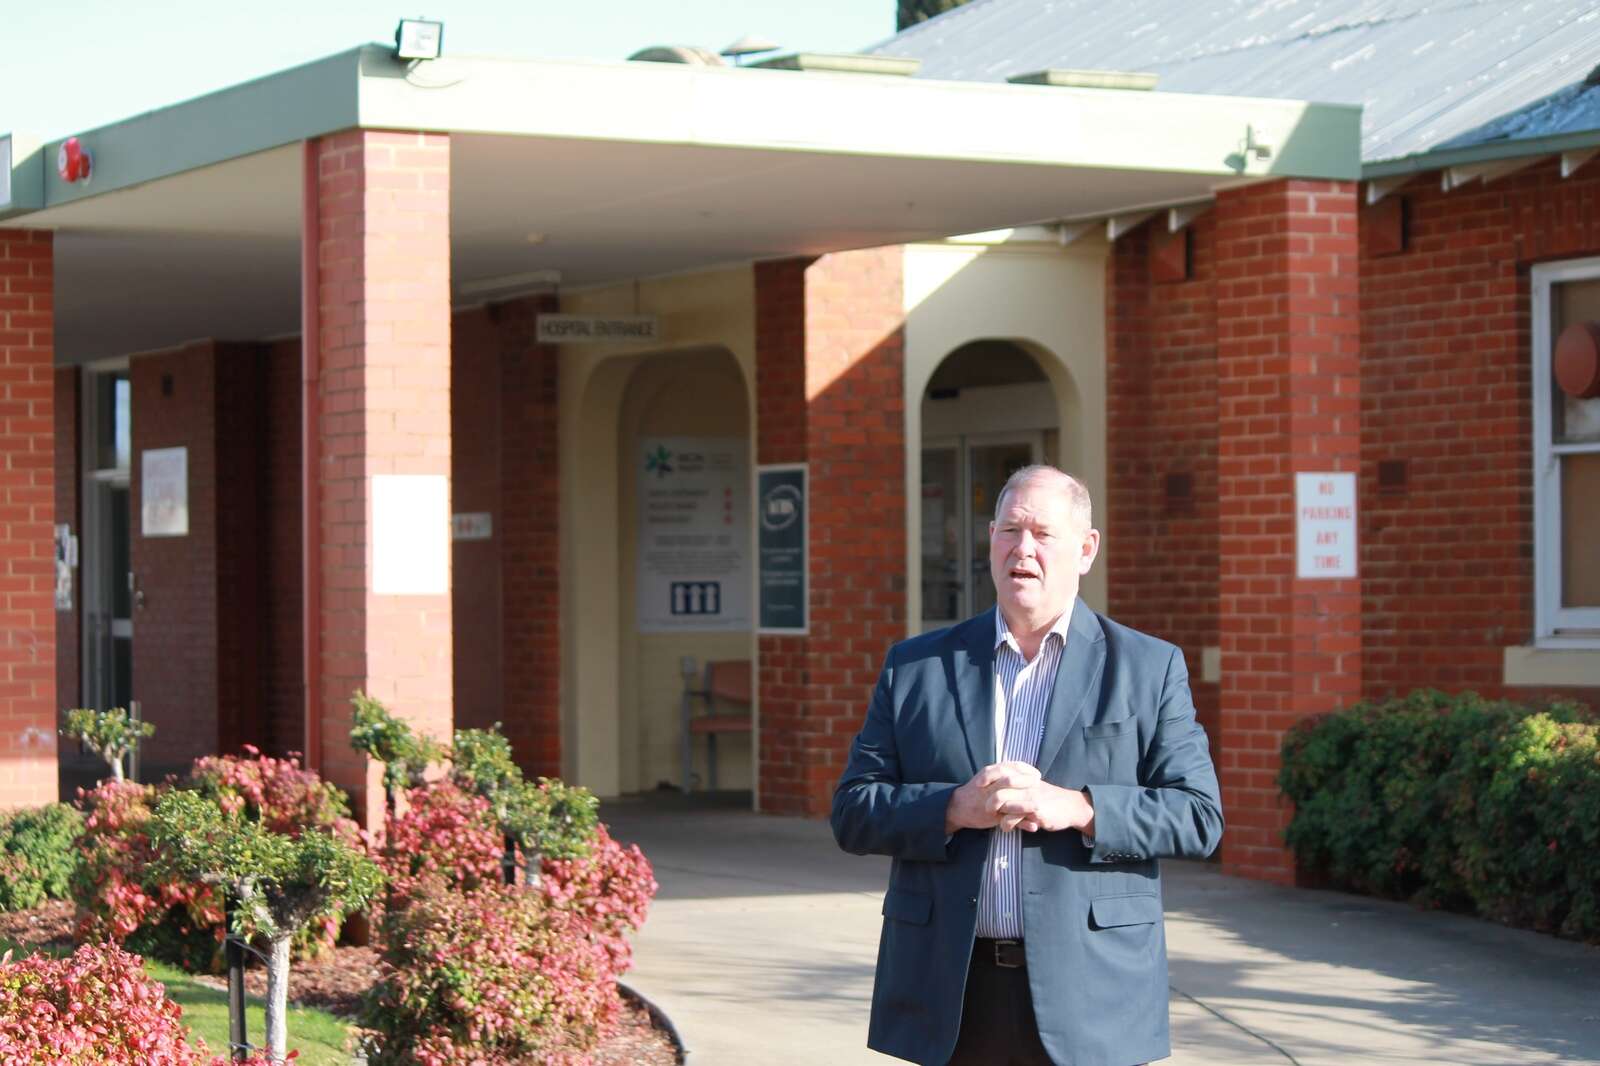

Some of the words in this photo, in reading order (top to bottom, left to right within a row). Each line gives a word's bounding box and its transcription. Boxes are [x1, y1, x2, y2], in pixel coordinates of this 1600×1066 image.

[541, 320, 590, 337] HOSPITAL
[595, 320, 656, 337] ENTRANCE
[1302, 506, 1352, 520] PARKING
